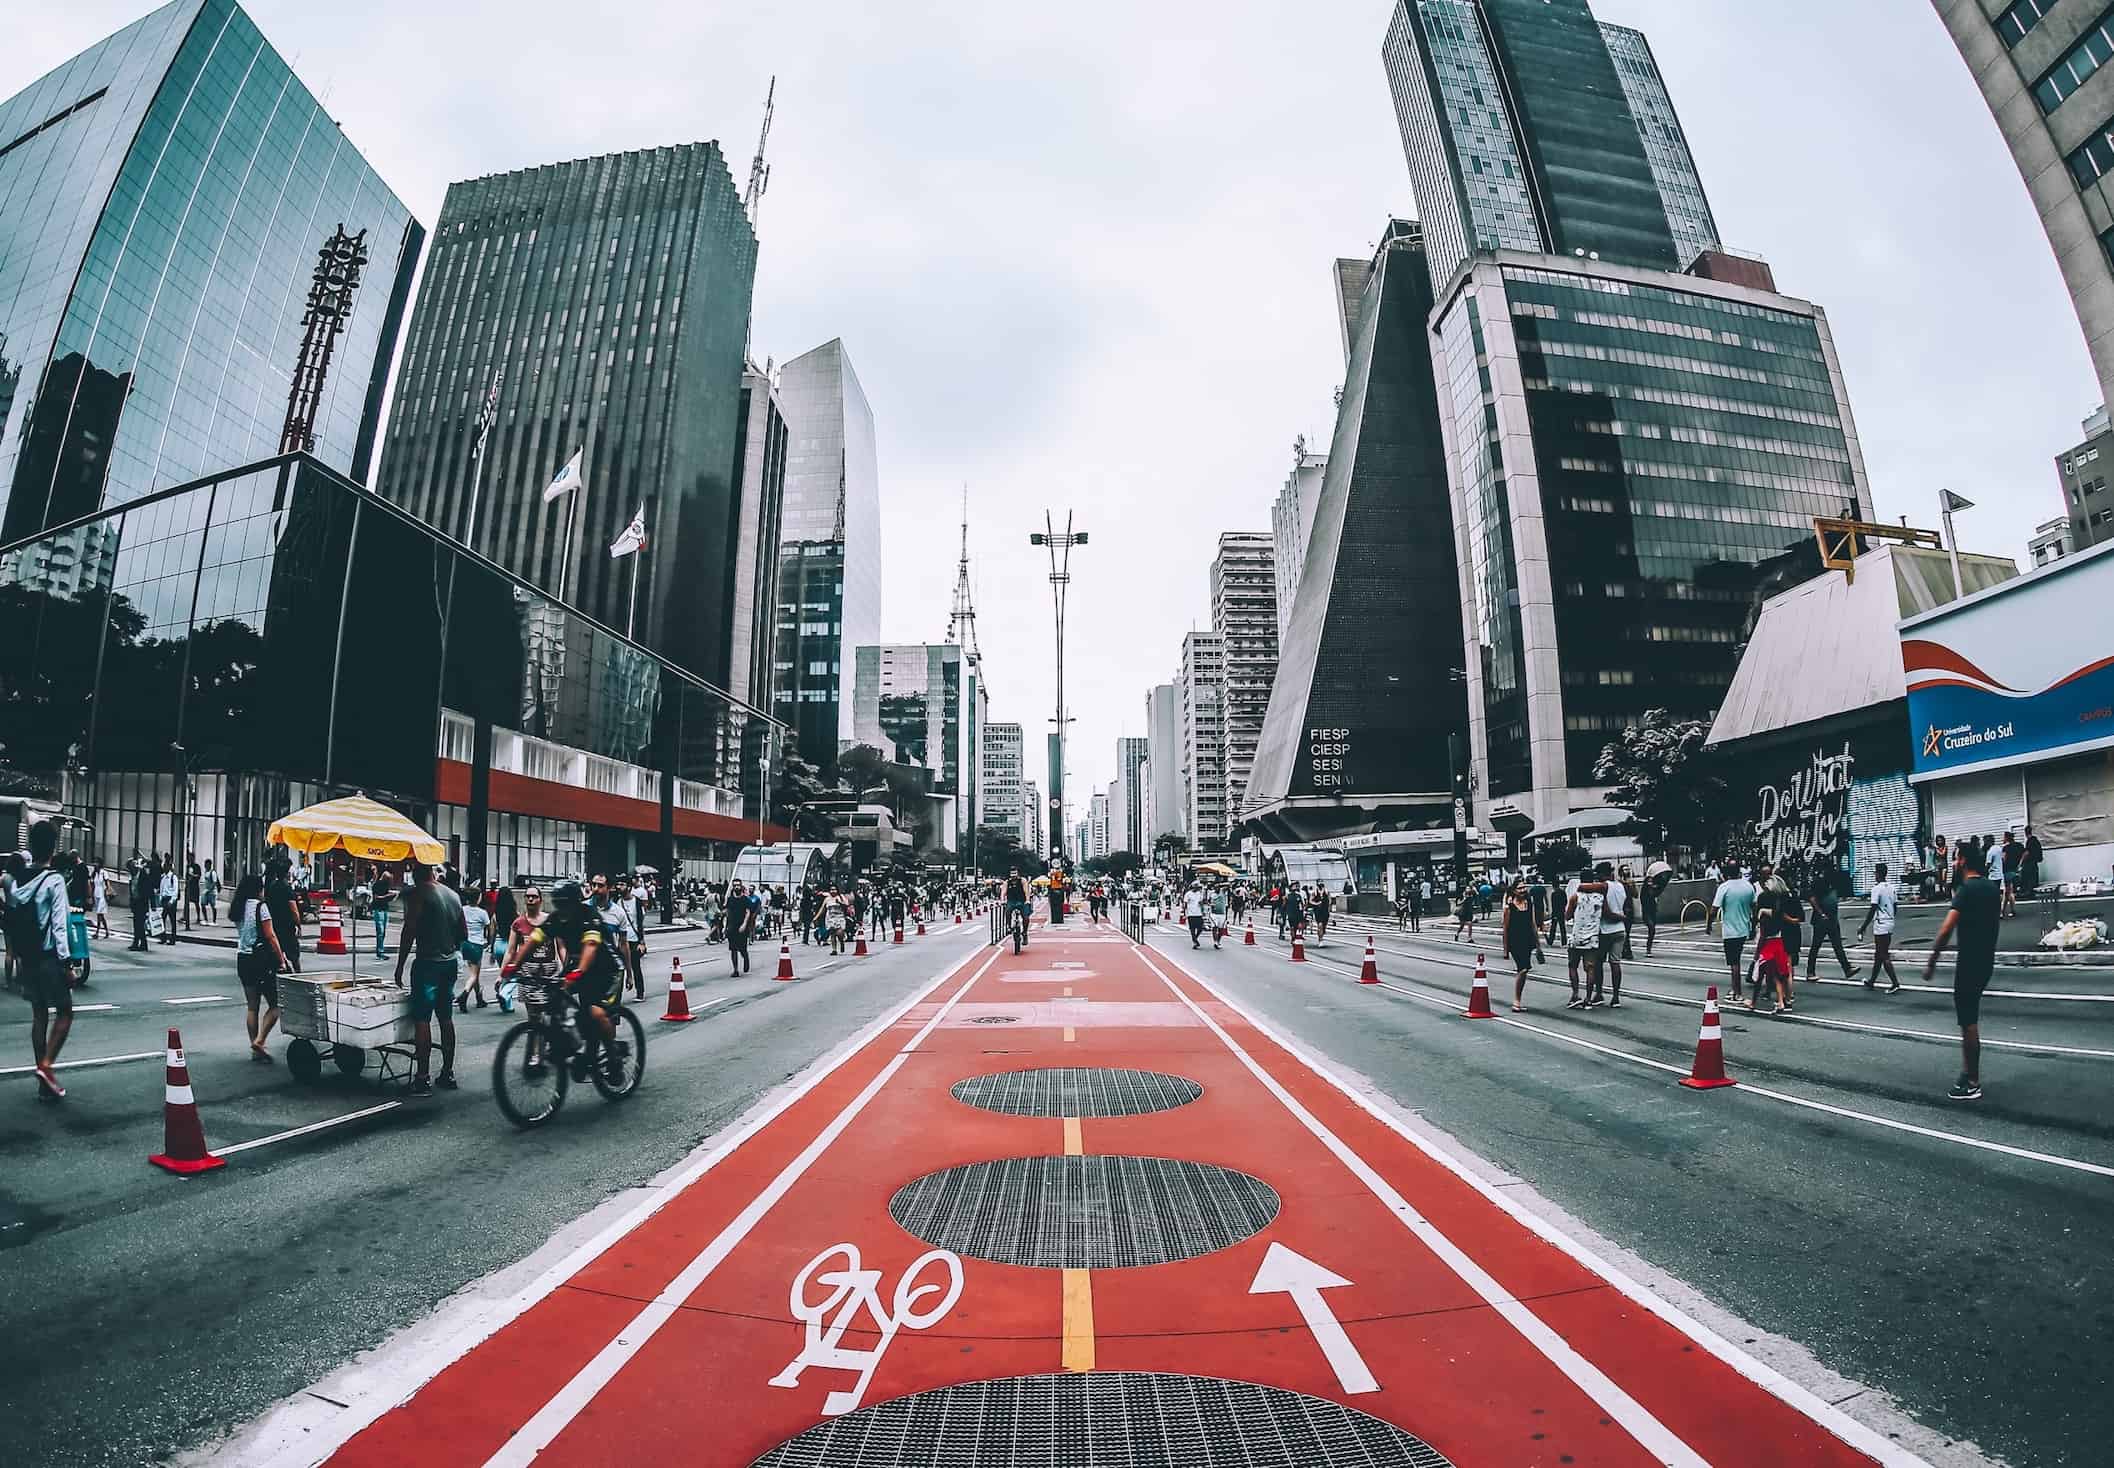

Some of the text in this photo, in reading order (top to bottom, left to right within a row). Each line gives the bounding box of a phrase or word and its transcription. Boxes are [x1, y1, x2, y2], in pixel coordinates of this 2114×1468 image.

[1310, 728, 1350, 740] FIESP
[1944, 721, 2014, 750] Cruzeiro do Sul
[1310, 743, 1351, 756] CIESP
[1312, 759, 1343, 771] SESI
